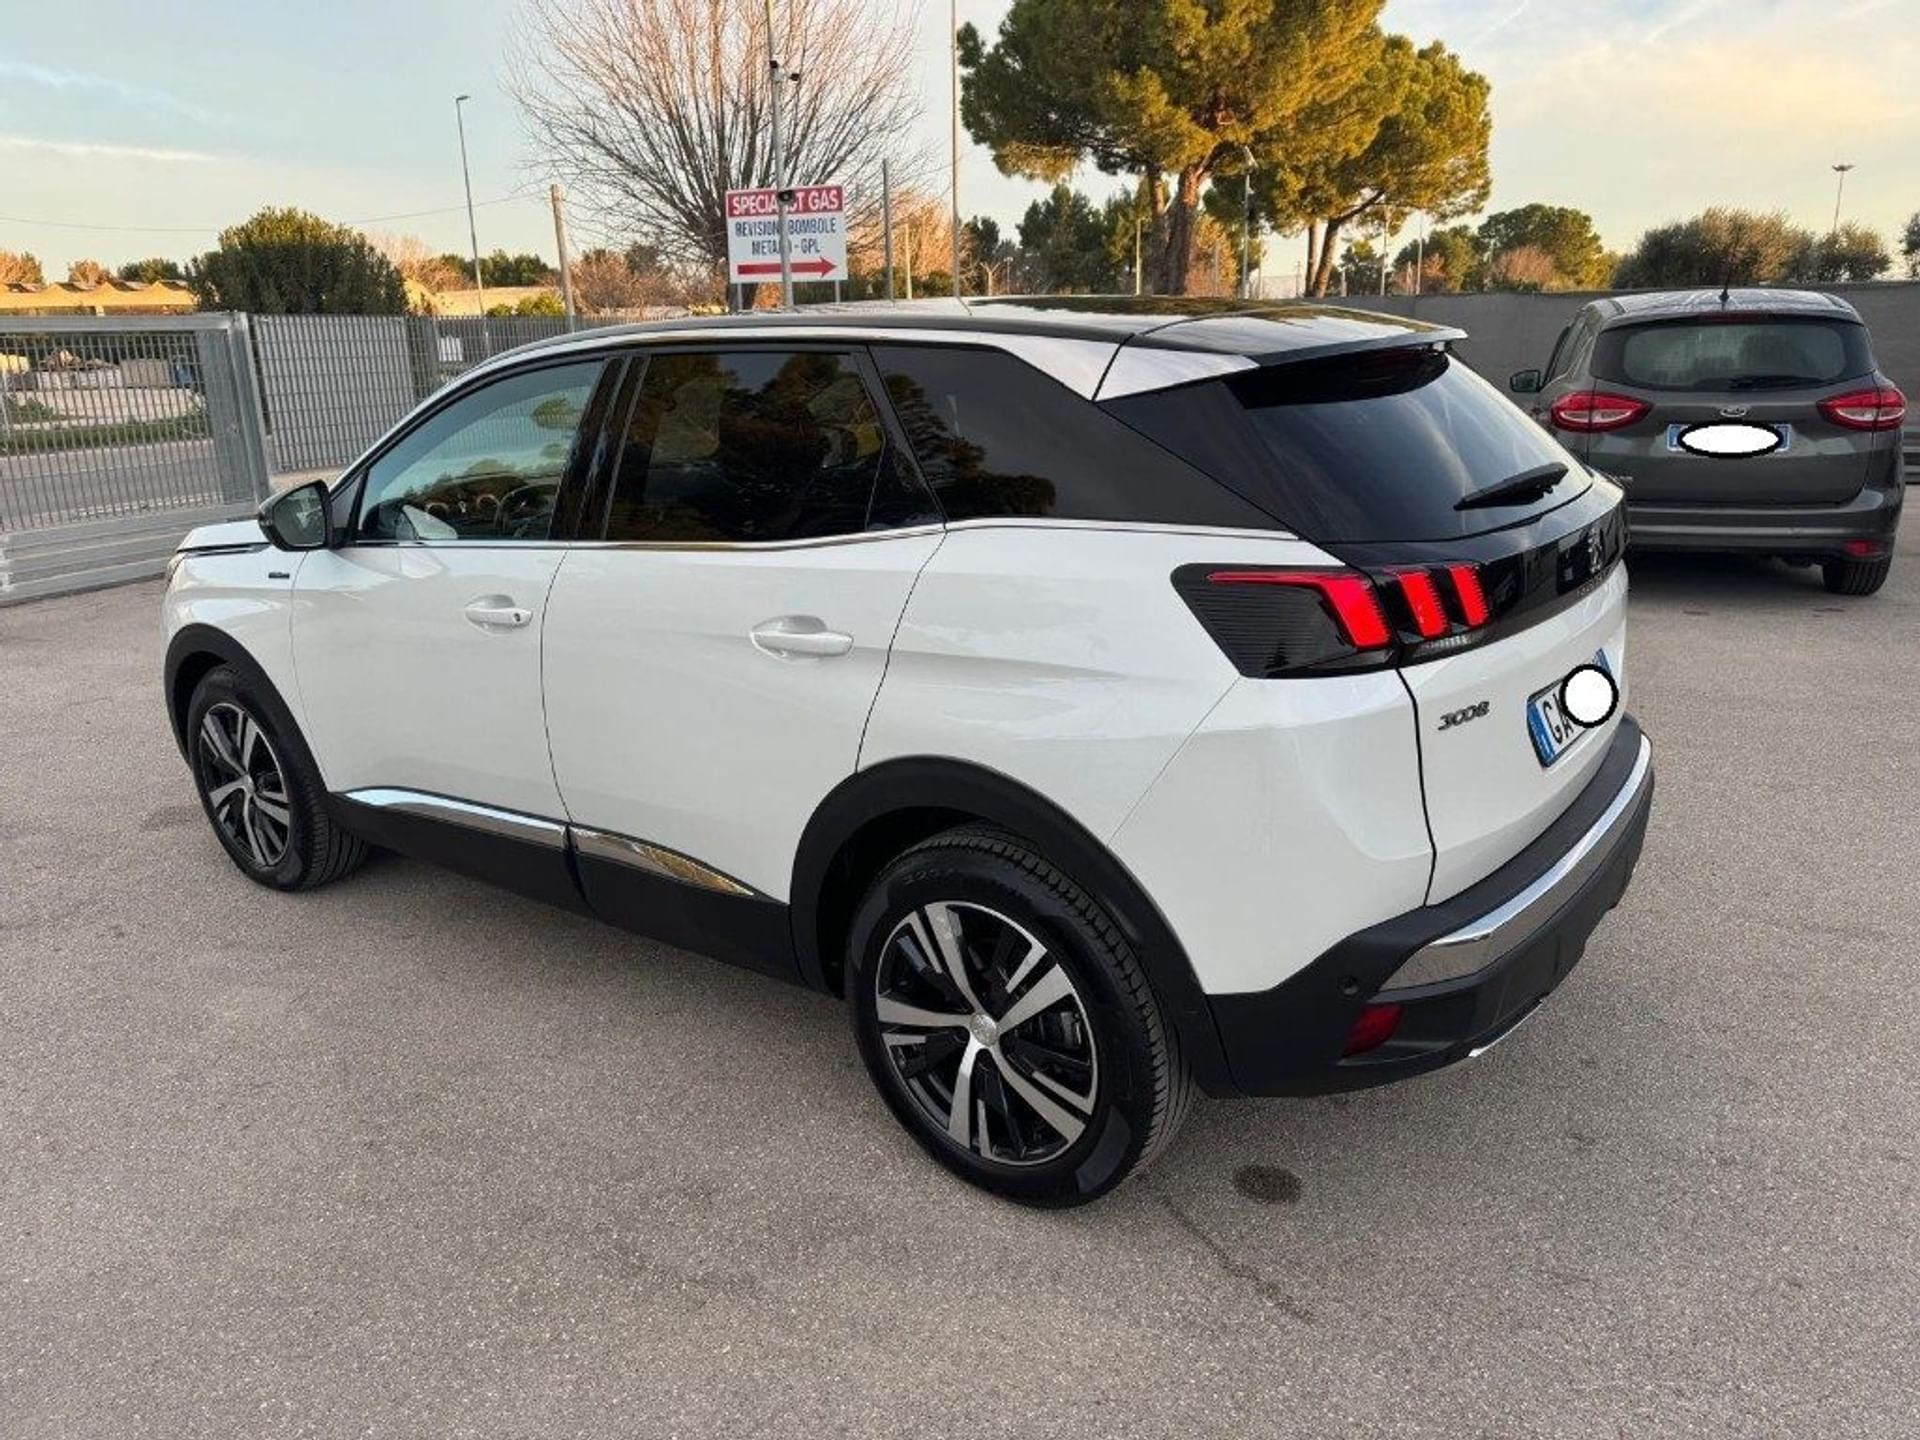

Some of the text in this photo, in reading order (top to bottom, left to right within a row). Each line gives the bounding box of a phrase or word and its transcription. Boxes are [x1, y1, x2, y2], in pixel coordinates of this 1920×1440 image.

[732, 189, 839, 215] SPECIAST GAS
[735, 217, 837, 237] REVISION BOMBOLE
[751, 238, 792, 256] METAO
[800, 237, 821, 254] GPL
[1437, 701, 1490, 731] 3008
